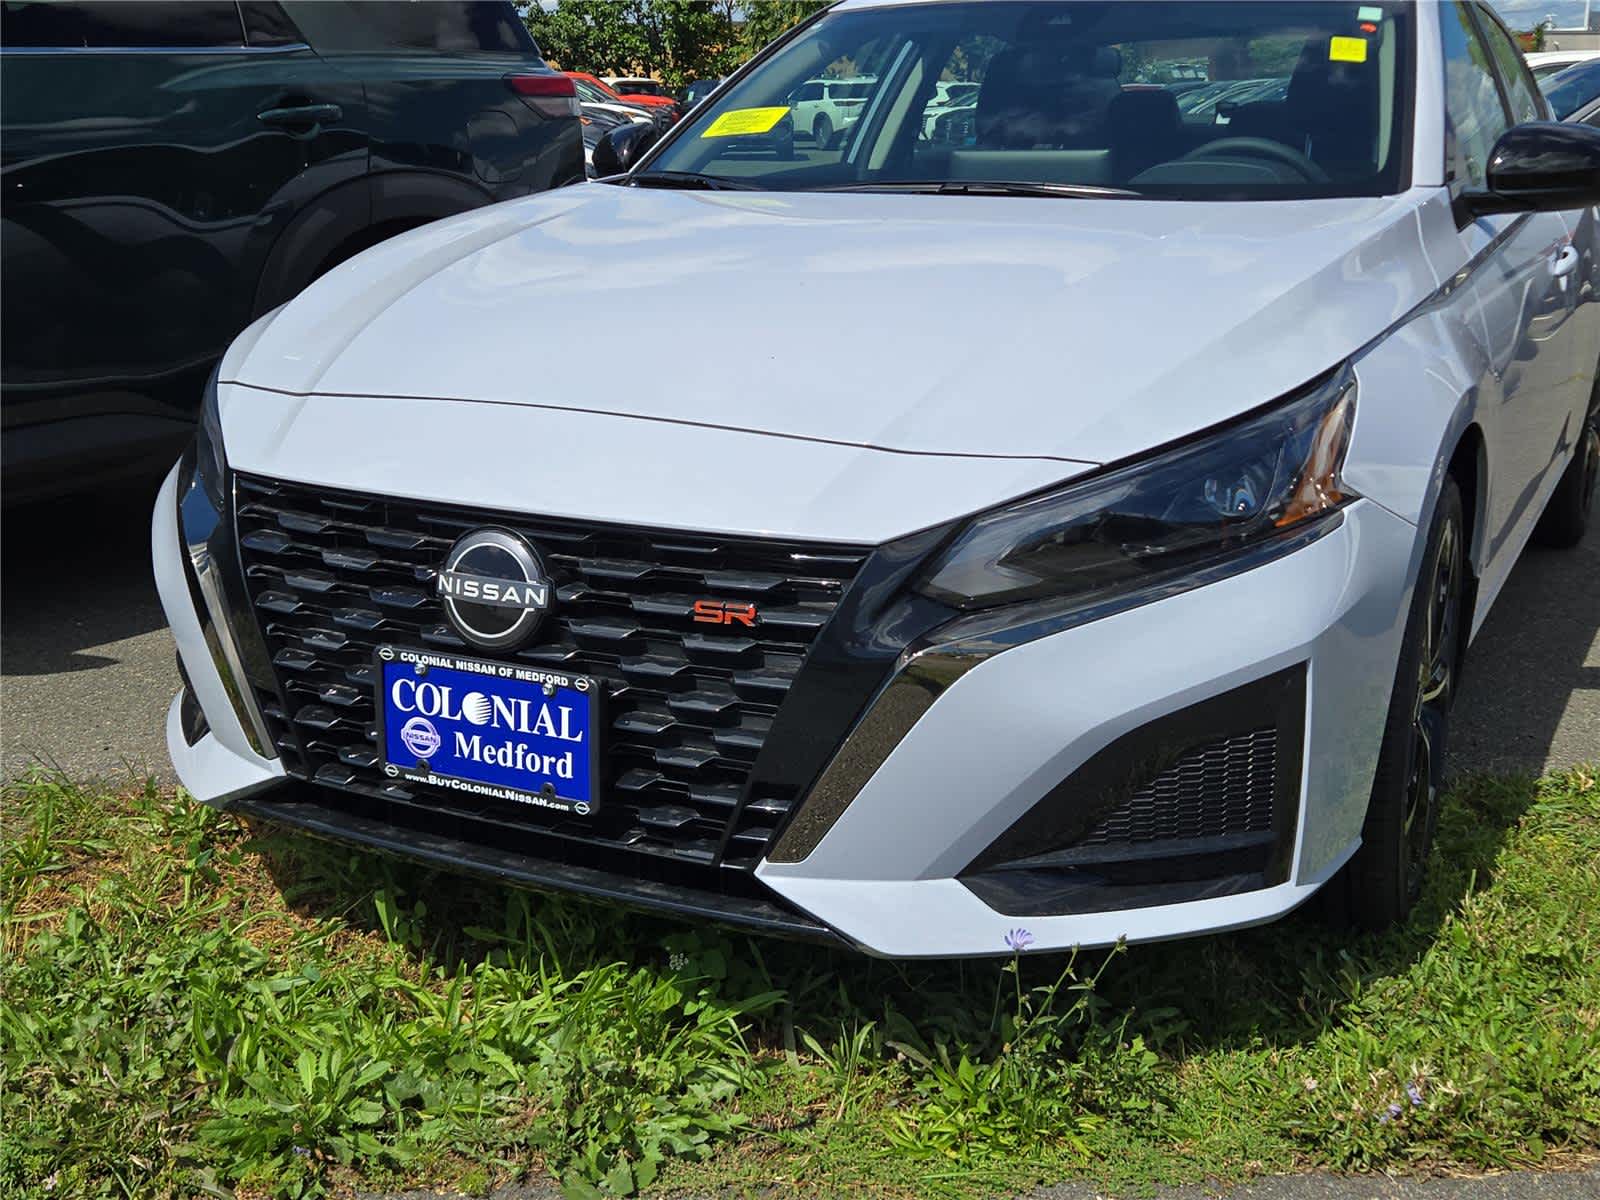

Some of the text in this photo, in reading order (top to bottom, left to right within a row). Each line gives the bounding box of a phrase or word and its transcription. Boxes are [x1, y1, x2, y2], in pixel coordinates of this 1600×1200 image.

[438, 574, 546, 606] NISSAN
[694, 600, 756, 627] SR
[400, 652, 569, 687] COLONIAL NISSAN OF MEDFORD
[392, 678, 583, 742] COLONIAL
[405, 730, 437, 744] NISSAN
[453, 731, 574, 779] Medford
